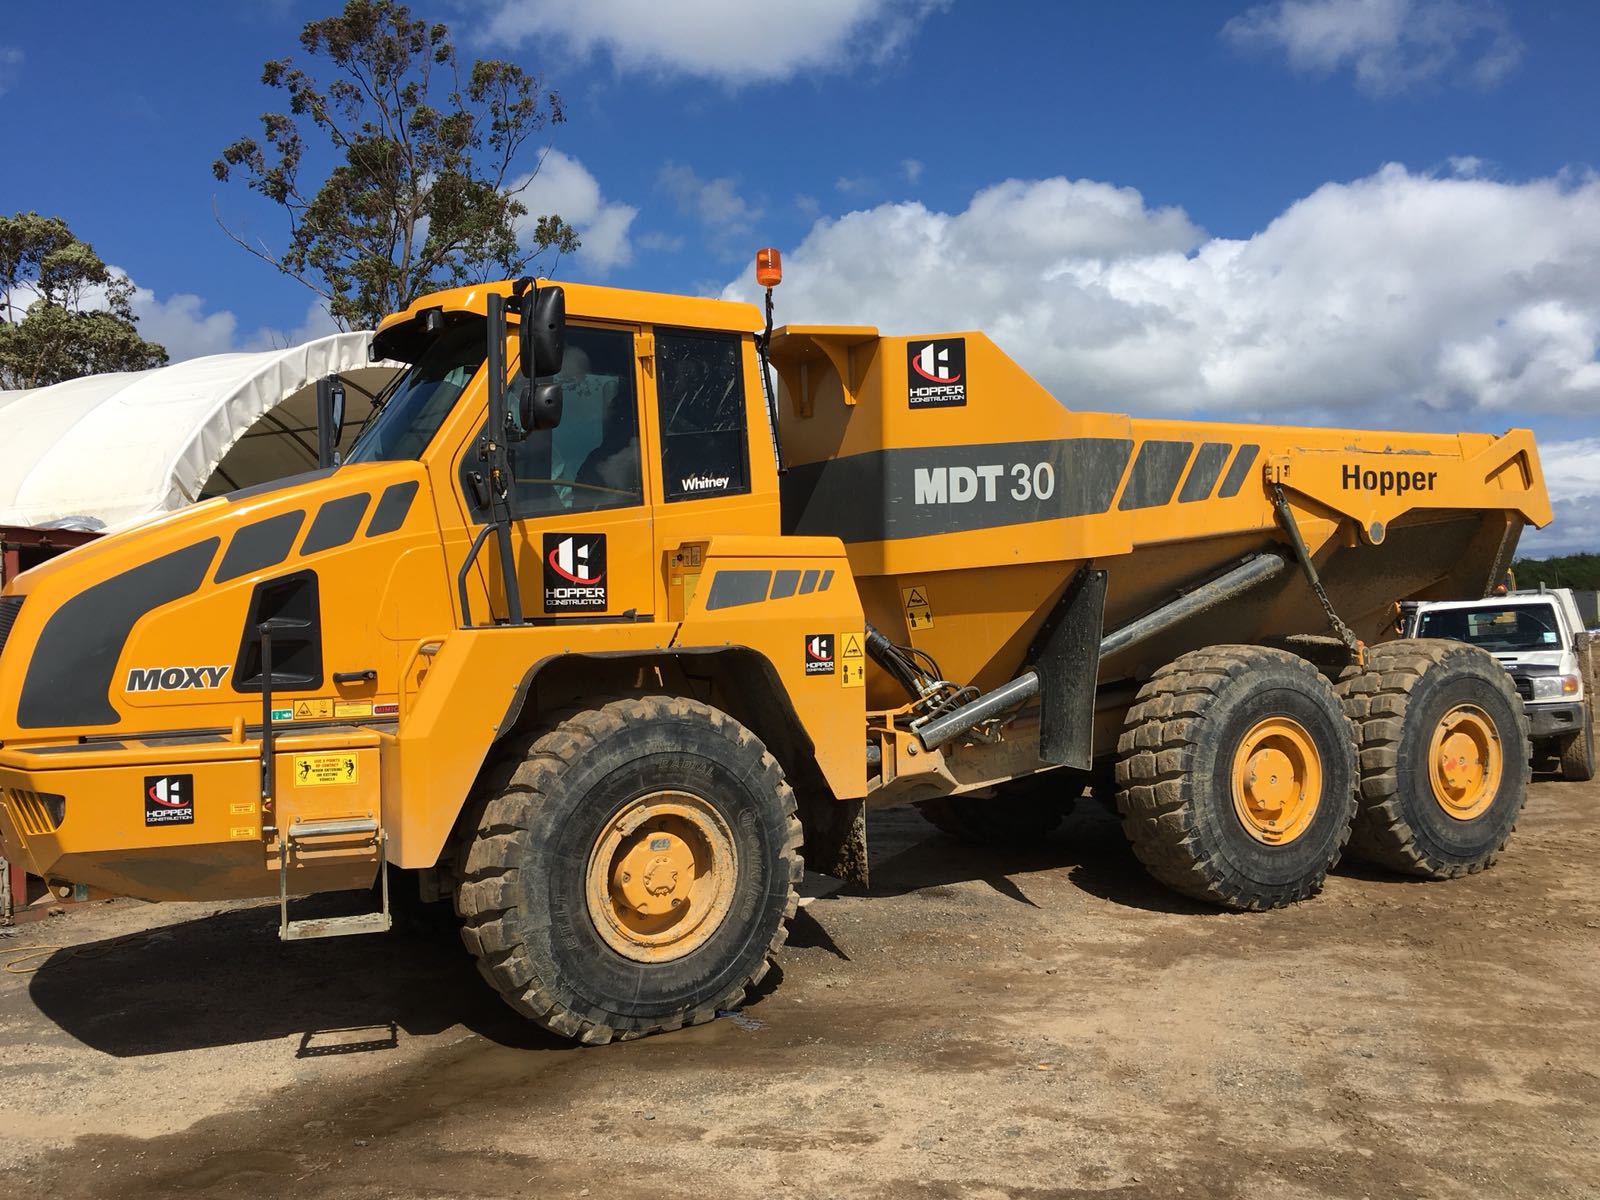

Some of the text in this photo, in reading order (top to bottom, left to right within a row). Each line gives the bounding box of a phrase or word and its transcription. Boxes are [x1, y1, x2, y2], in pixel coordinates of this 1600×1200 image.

[909, 385, 964, 397] HOPPER
[910, 394, 965, 403] CONSTRUCTION
[681, 476, 730, 491] Whitney
[914, 462, 1055, 505] MDT 30
[1342, 464, 1437, 496] Hopper
[545, 587, 605, 599] HOPPER
[546, 598, 606, 606] CONSTRUCTION
[806, 661, 834, 669] HOPPER
[125, 665, 231, 692] MOXY
[146, 808, 192, 818] HOPPER
[146, 815, 193, 823] CONSTRUCTION
